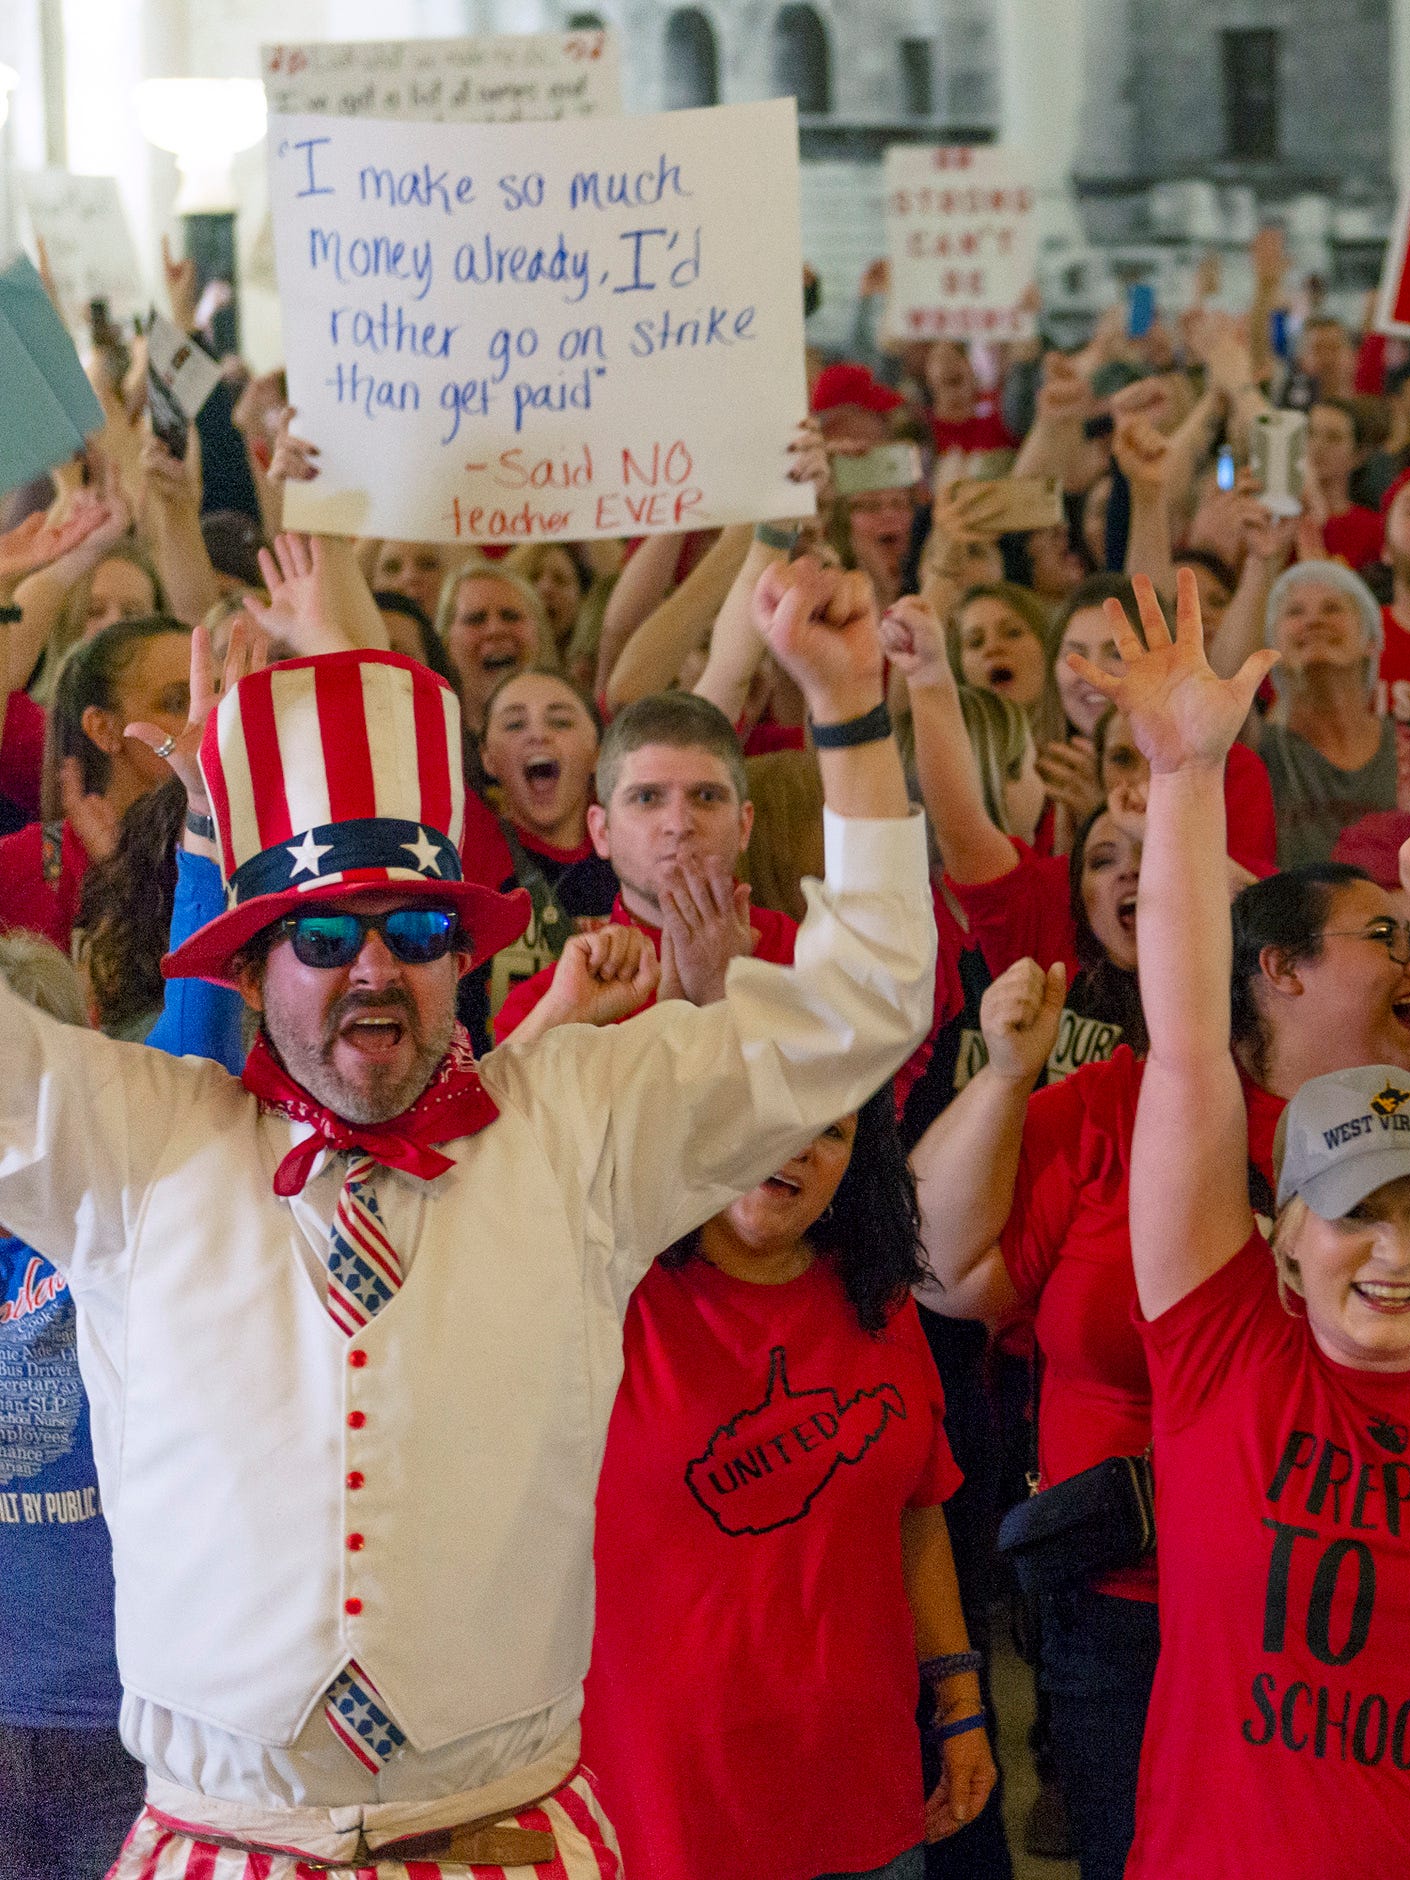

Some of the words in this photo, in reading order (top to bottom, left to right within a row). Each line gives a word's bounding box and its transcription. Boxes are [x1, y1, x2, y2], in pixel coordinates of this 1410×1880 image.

[358, 162, 477, 215] make
[501, 172, 547, 212] so
[569, 153, 696, 210] much
[612, 225, 701, 294] I'd
[329, 303, 461, 359] rather
[489, 329, 540, 382] go
[558, 325, 608, 361] on
[628, 302, 758, 358] strike
[325, 361, 420, 420] than
[439, 374, 492, 446] get
[621, 439, 695, 488] NO
[448, 496, 573, 538] teacher
[595, 488, 710, 530] EVER
[1322, 1114, 1373, 1151] WEST
[0, 1379, 59, 1396] ecretary
[26, 1361, 73, 1377] Driver
[28, 1396, 66, 1414] SLP
[708, 1411, 839, 1495] UNITED
[21, 1493, 42, 1523] BY
[45, 1485, 97, 1524] PUBLIC
[1261, 1517, 1377, 1667] TO
